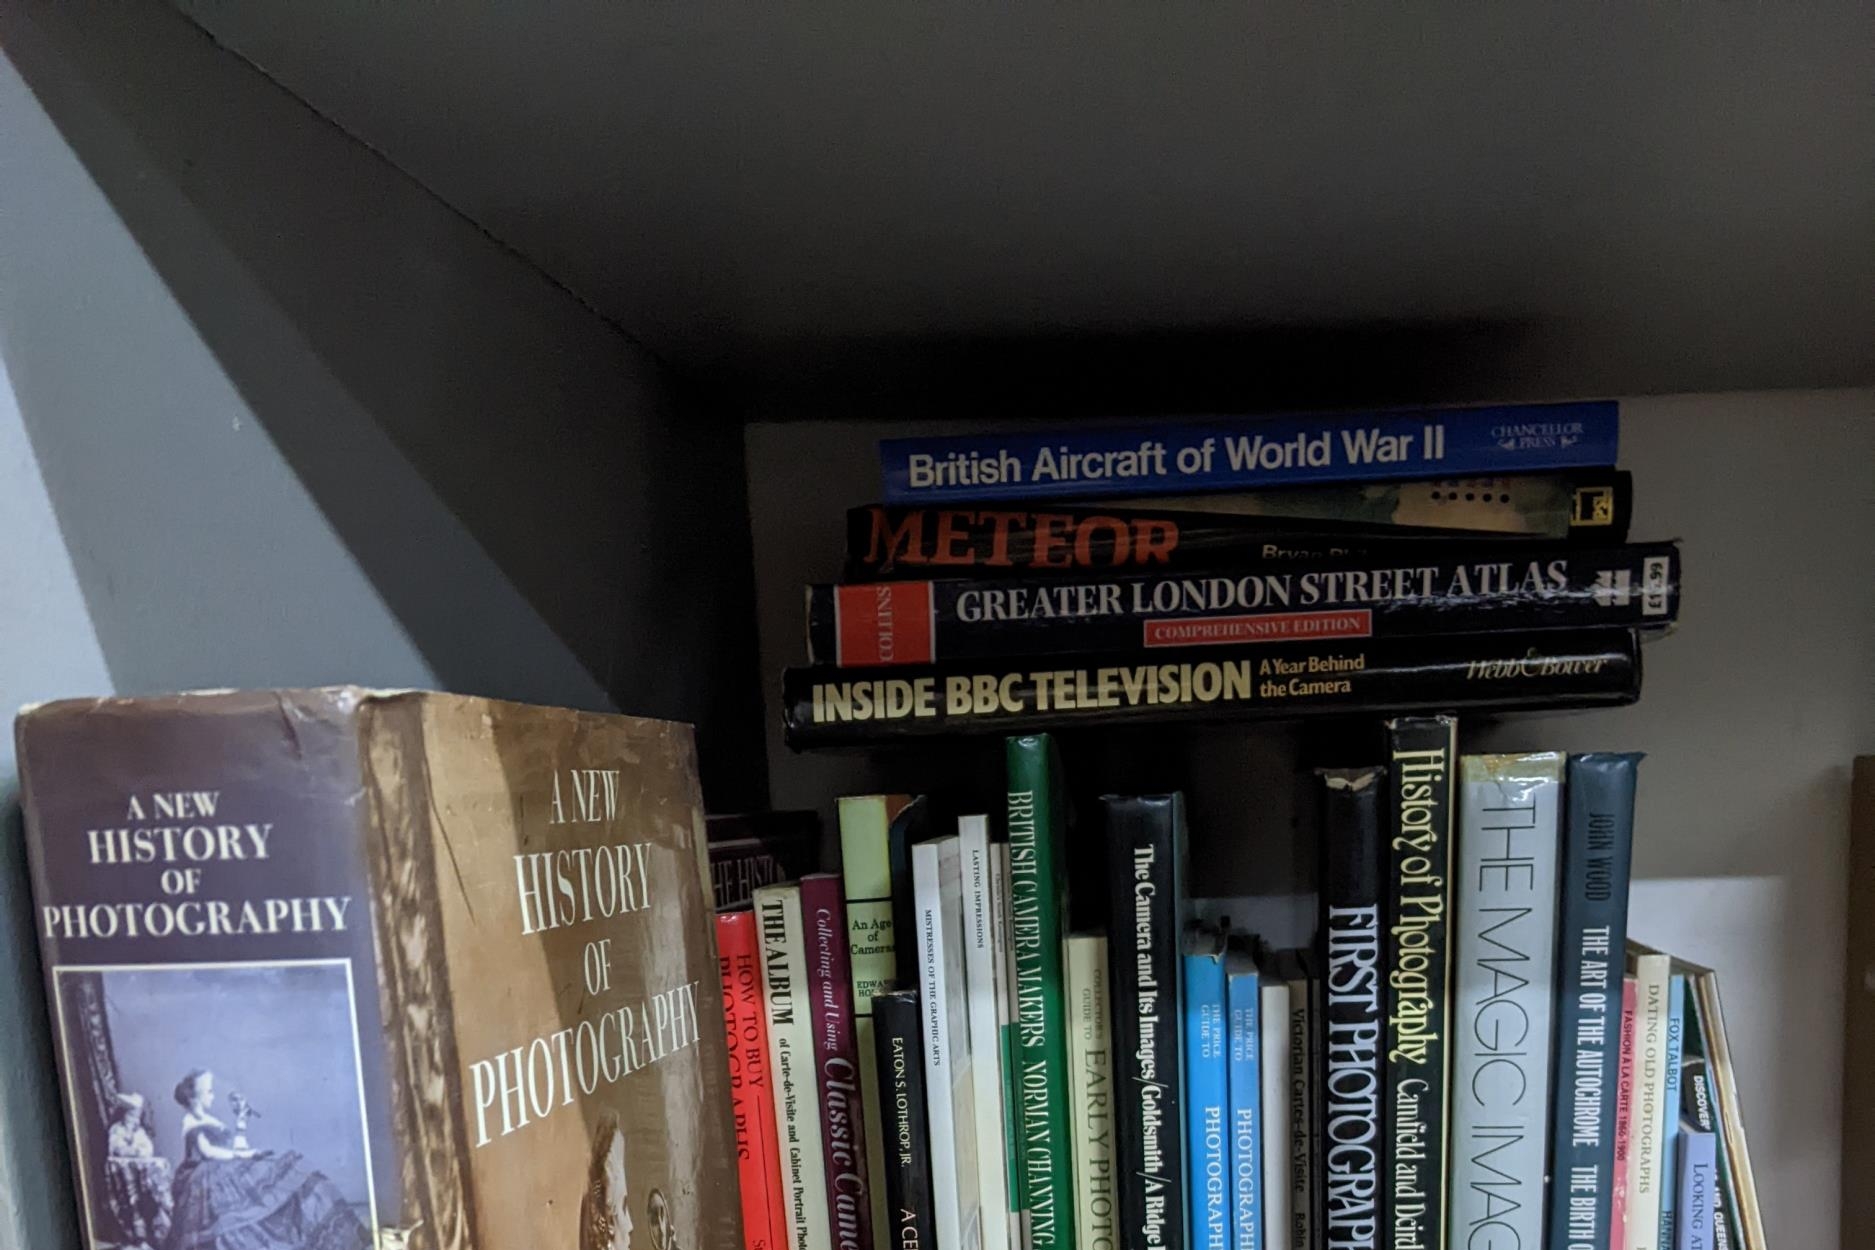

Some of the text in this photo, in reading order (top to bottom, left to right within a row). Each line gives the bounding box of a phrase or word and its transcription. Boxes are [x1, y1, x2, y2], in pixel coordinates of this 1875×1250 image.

[908, 424, 1446, 488] British Aircraft of World War II
[864, 505, 1179, 569] METEOR
[956, 560, 1567, 622] GREATER LONDON STREET ATLAS
[1154, 616, 1361, 641] COMPREHENSIVE EDITION
[812, 659, 1251, 723] INSIDE BBC TELEVISION
[1260, 653, 1366, 675] A Behind
[1260, 678, 1352, 698] the Camera
[152, 790, 220, 820] NEW
[570, 768, 620, 824] NEW
[86, 822, 274, 864] HISTORY
[1008, 789, 1037, 875] BRITISH
[1134, 843, 1155, 880] The
[1478, 792, 1537, 893] THE
[160, 867, 202, 896] OF
[512, 841, 652, 936] HISTORY
[972, 849, 985, 950] LASTING IMPRESSIONS
[42, 895, 353, 940] PHOTOGRAPHY
[1011, 880, 1041, 962] CAMERA
[1135, 881, 1156, 951] Camera
[1580, 925, 1610, 957] THE
[583, 937, 612, 996] OF
[760, 899, 795, 1026] THE ALBUM
[925, 909, 941, 1067] MISTRESSES THE GRAPHIC ARTS
[1136, 953, 1157, 988] and
[1328, 903, 1380, 1014] FIRST
[1389, 749, 1446, 1199] History of Photography Camfield and
[1579, 960, 1608, 989] ART
[823, 974, 839, 1008] and
[1015, 965, 1047, 1049] MAKERS
[1082, 987, 1093, 1023] GUIDE
[1201, 1003, 1210, 1037] GUIDE
[1471, 907, 1534, 1108] MAGIC
[1645, 983, 1661, 1043] DATING
[891, 1037, 908, 1079] EATON
[1211, 1027, 1222, 1058] PRICE
[1292, 1007, 1305, 1075] Victorian
[1575, 1015, 1606, 1047] THE
[1668, 1017, 1680, 1042] FOX
[468, 979, 701, 1150] PHOTOGRAPHY
[1618, 1009, 1633, 1113] FASHION CARTE
[1644, 1047, 1658, 1080] OLD
[1666, 1045, 1679, 1092] TALBOT
[823, 1056, 858, 1167] Classic
[896, 1093, 912, 1152] LOTHROP,
[1021, 1059, 1052, 1145] NORMAN
[1085, 1047, 1110, 1149] EARLY
[1571, 1050, 1604, 1147] AUTOCHROME
[1292, 1079, 1306, 1193] Cartes-de-Visite
[787, 1124, 808, 1225] and Cabinet Portrait
[1025, 1146, 1057, 1246] CHANNING
[1569, 1164, 1599, 1193] THE
[899, 1208, 917, 1223] A
[1141, 1195, 1166, 1244] Ridge
[1295, 1211, 1306, 1249] Robin
[1567, 1197, 1597, 1240] BIRTH
[1690, 1234, 1704, 1250] AT
